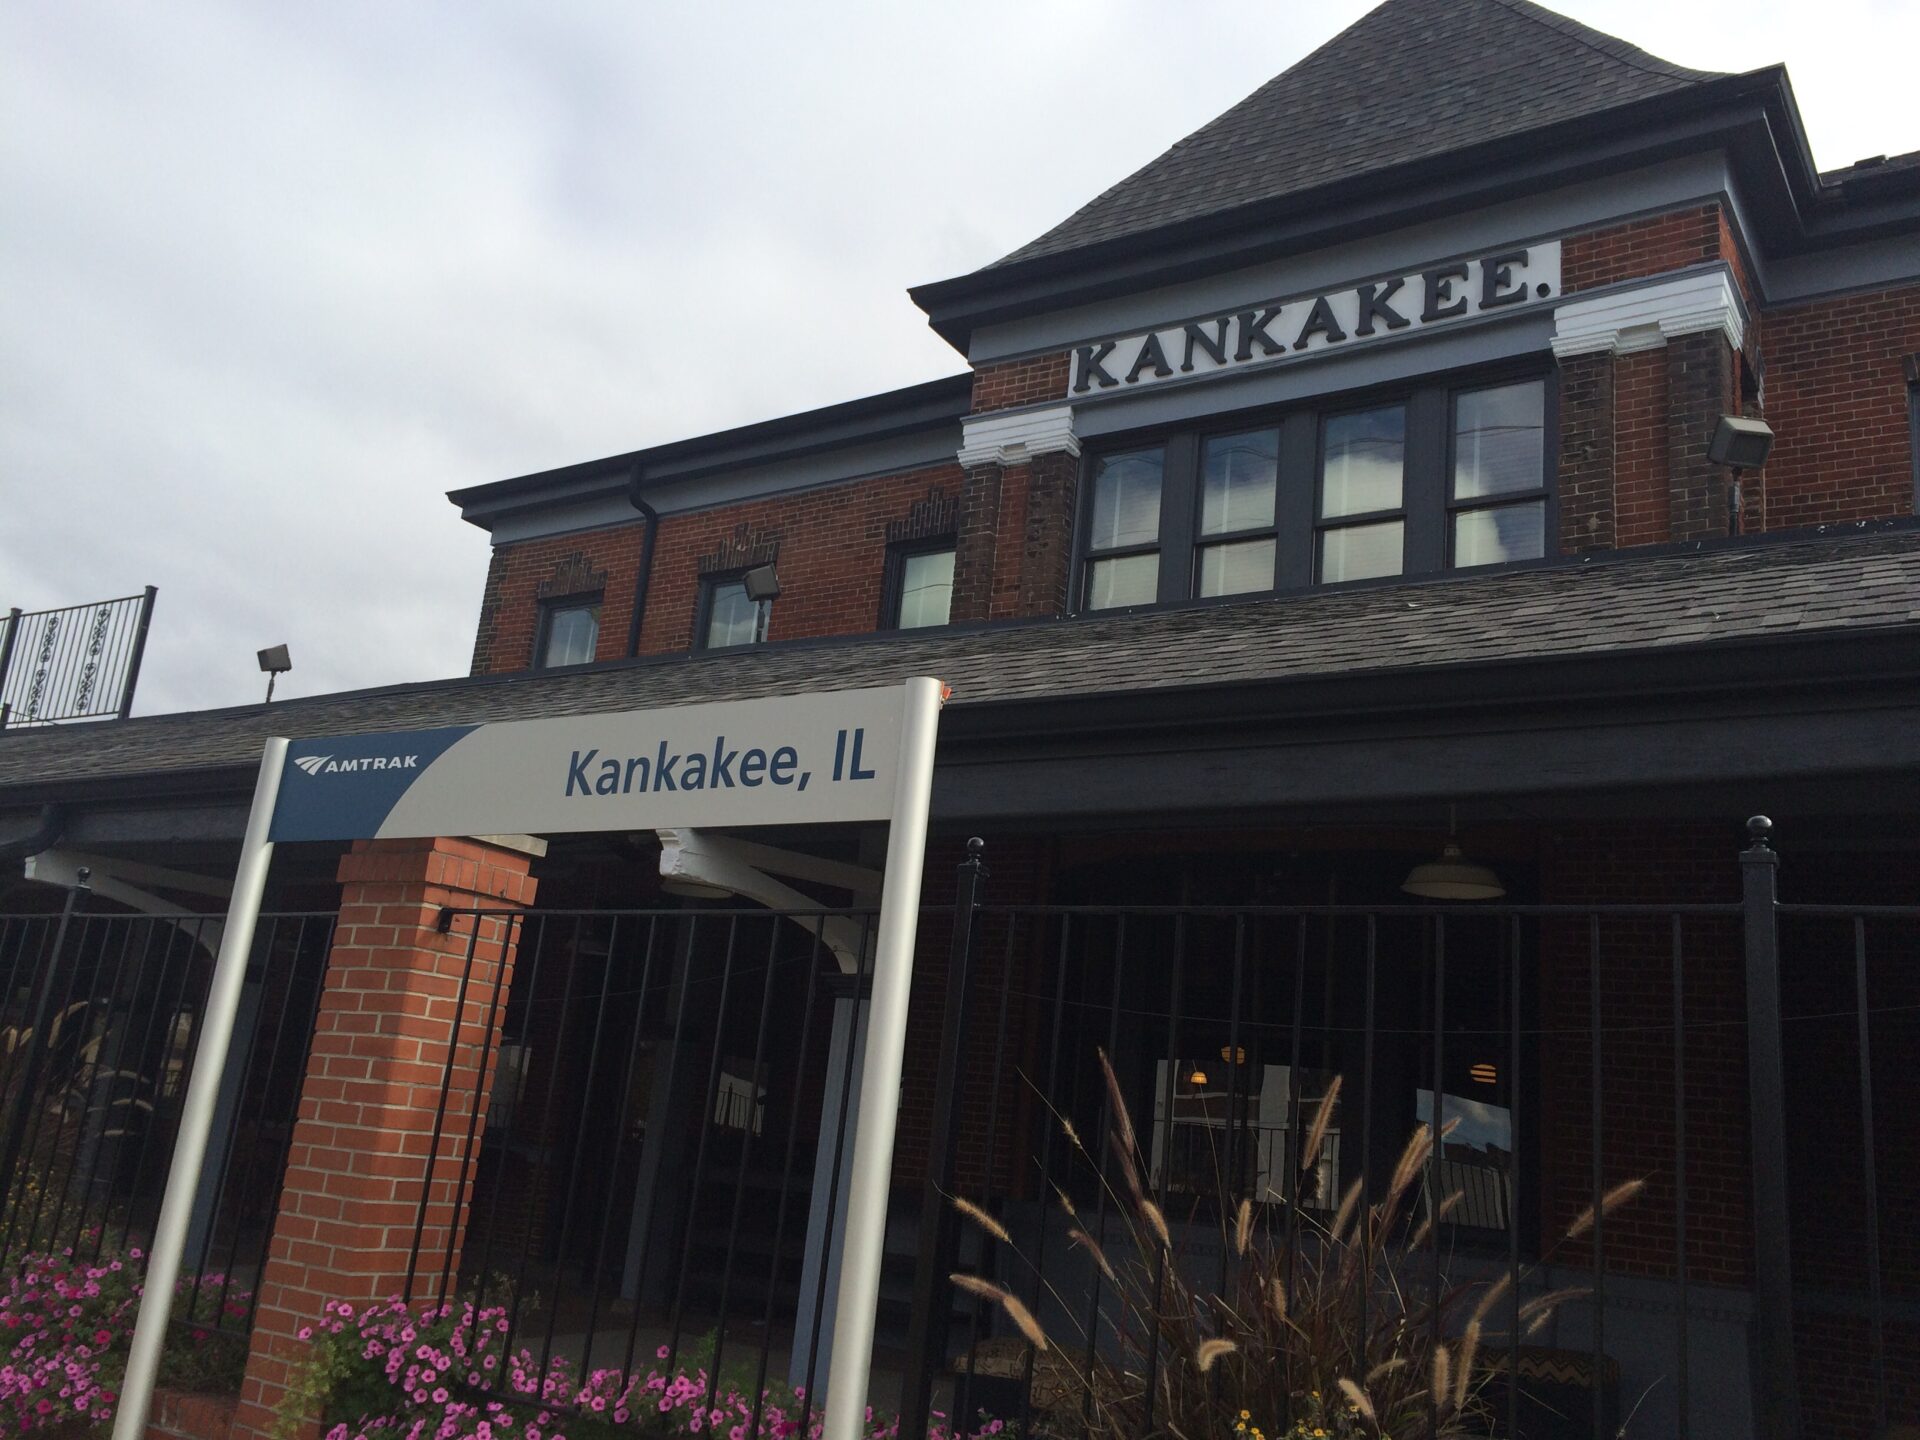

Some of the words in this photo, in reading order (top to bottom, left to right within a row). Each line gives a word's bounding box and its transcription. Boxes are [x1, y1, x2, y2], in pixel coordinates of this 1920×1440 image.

[1073, 249, 1552, 393] KANKAKEE.
[324, 755, 418, 773] AMTRAK
[565, 736, 811, 797] Kankakee,
[832, 728, 875, 781] IL
